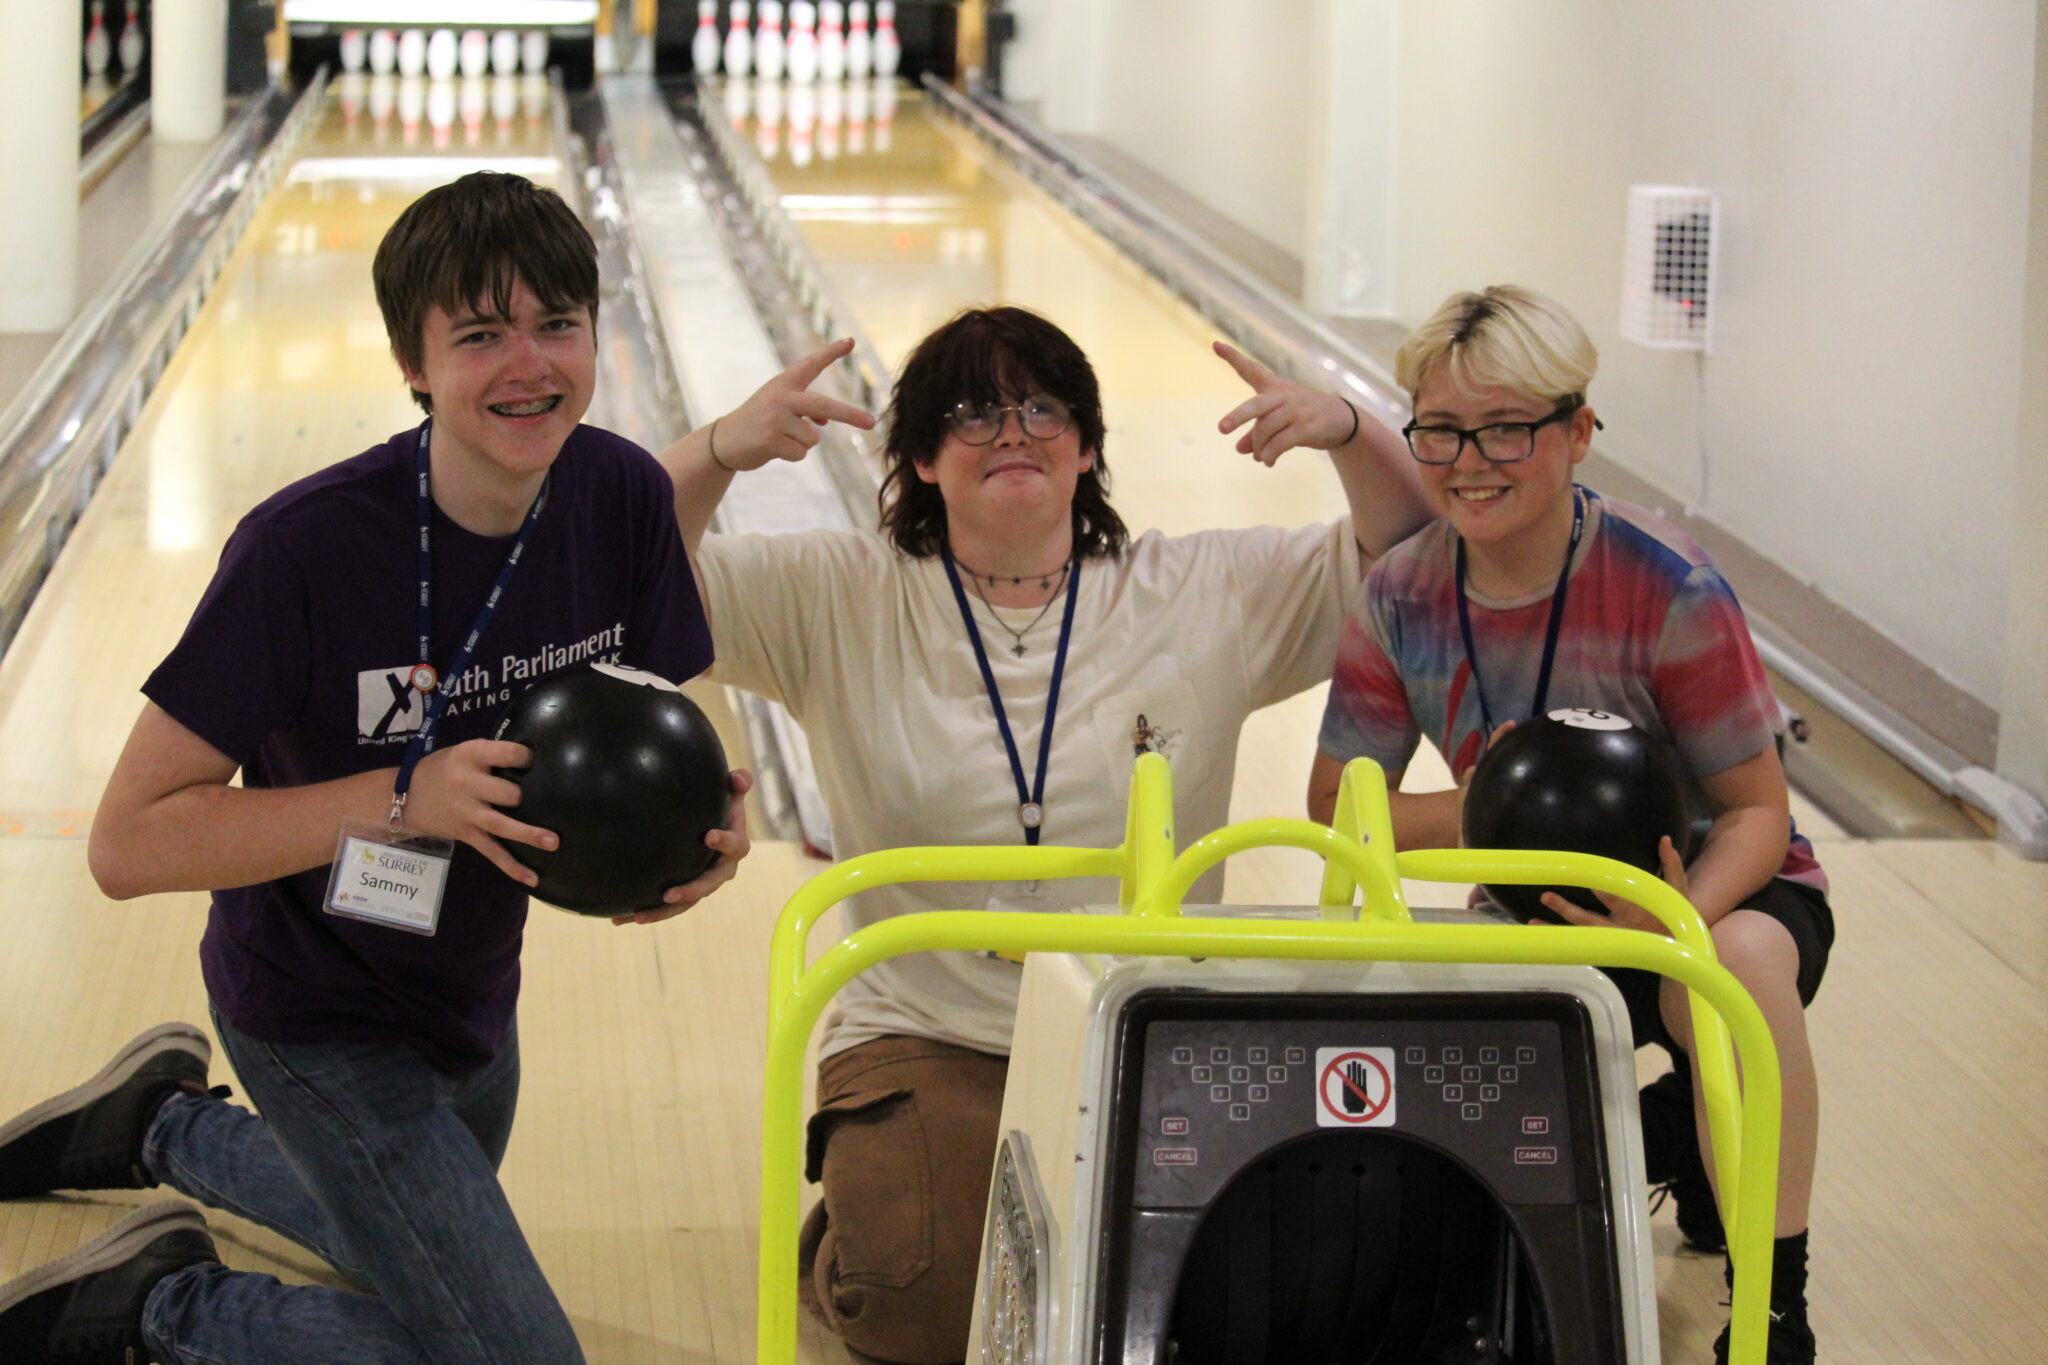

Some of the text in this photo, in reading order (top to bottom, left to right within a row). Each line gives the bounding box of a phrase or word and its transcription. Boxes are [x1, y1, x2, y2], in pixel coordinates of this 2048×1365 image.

[502, 622, 625, 683] Parliament
[438, 688, 511, 718] AKING
[377, 854, 428, 877] SURREY
[360, 871, 419, 900] Sammy
[1166, 1121, 1183, 1130] SET
[1526, 1120, 1543, 1129] SET
[1157, 1152, 1193, 1161] CANCEL
[1518, 1151, 1552, 1160] CANCEL
